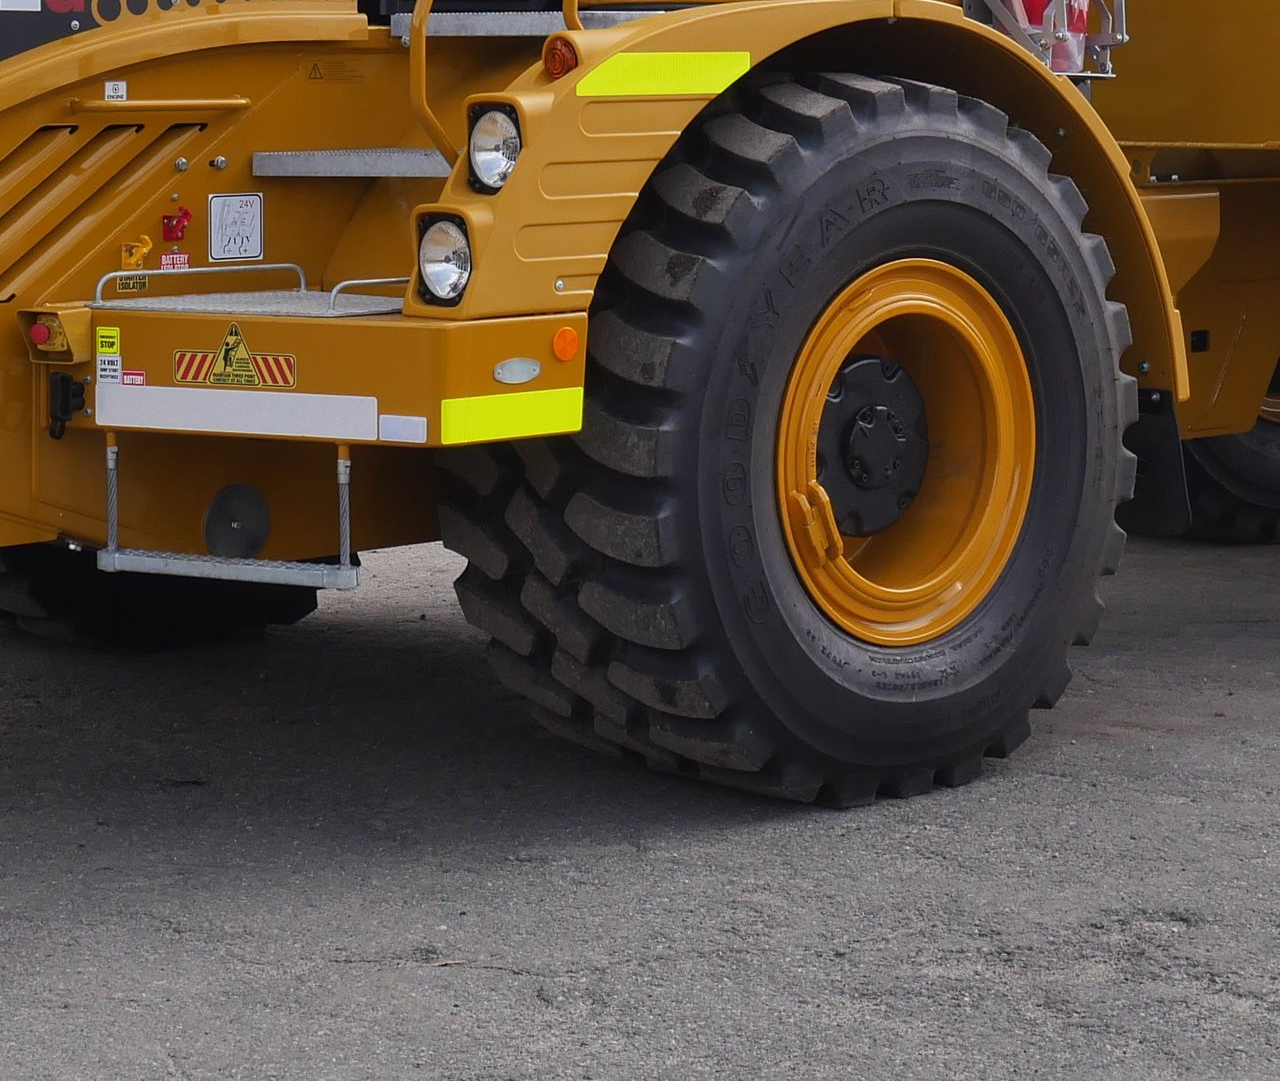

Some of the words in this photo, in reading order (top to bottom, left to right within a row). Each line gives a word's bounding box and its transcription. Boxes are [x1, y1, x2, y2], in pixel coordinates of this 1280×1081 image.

[239, 199, 255, 209] 24V
[161, 254, 189, 265] BATTERY
[118, 281, 147, 291] ISOLATOR
[100, 340, 116, 349] STOP
